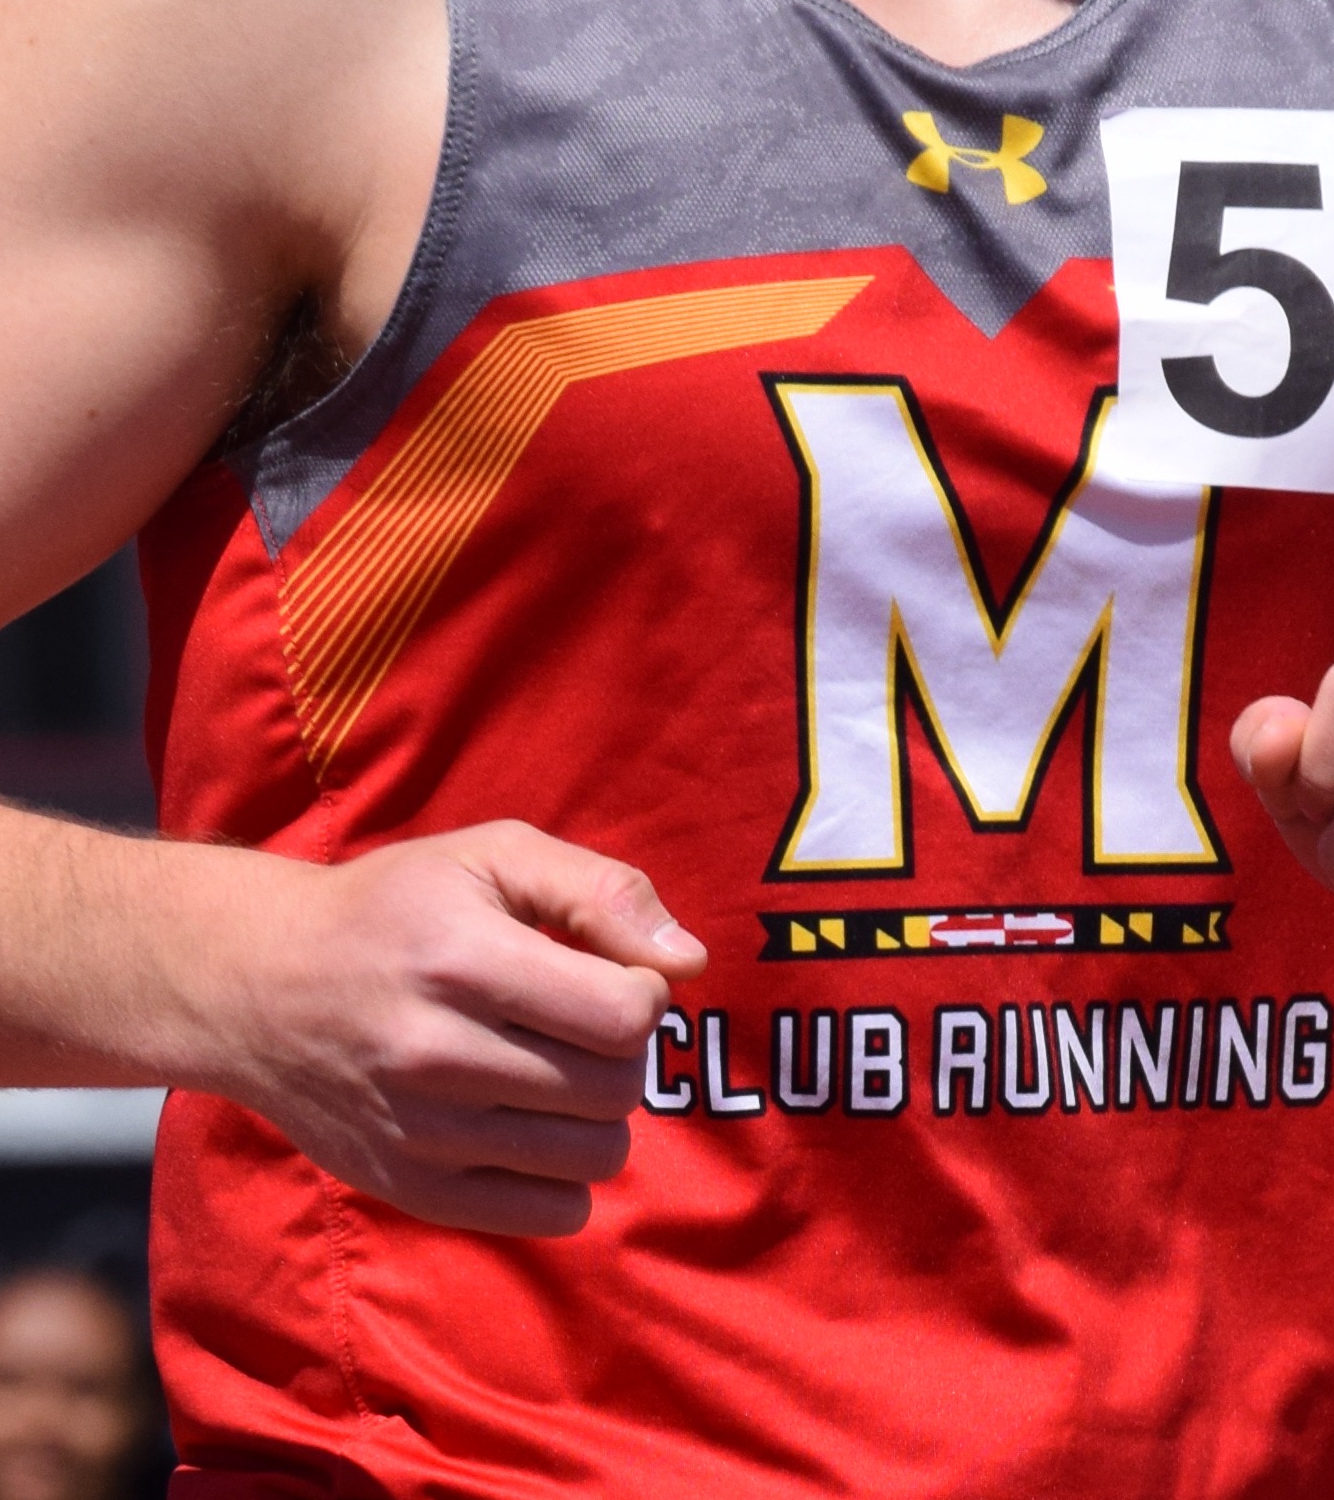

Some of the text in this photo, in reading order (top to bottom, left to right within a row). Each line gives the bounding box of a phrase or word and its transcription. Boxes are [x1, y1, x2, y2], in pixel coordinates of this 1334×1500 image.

[759, 372, 1233, 883] M
[642, 998, 1334, 1116] CLUB RUNNING
